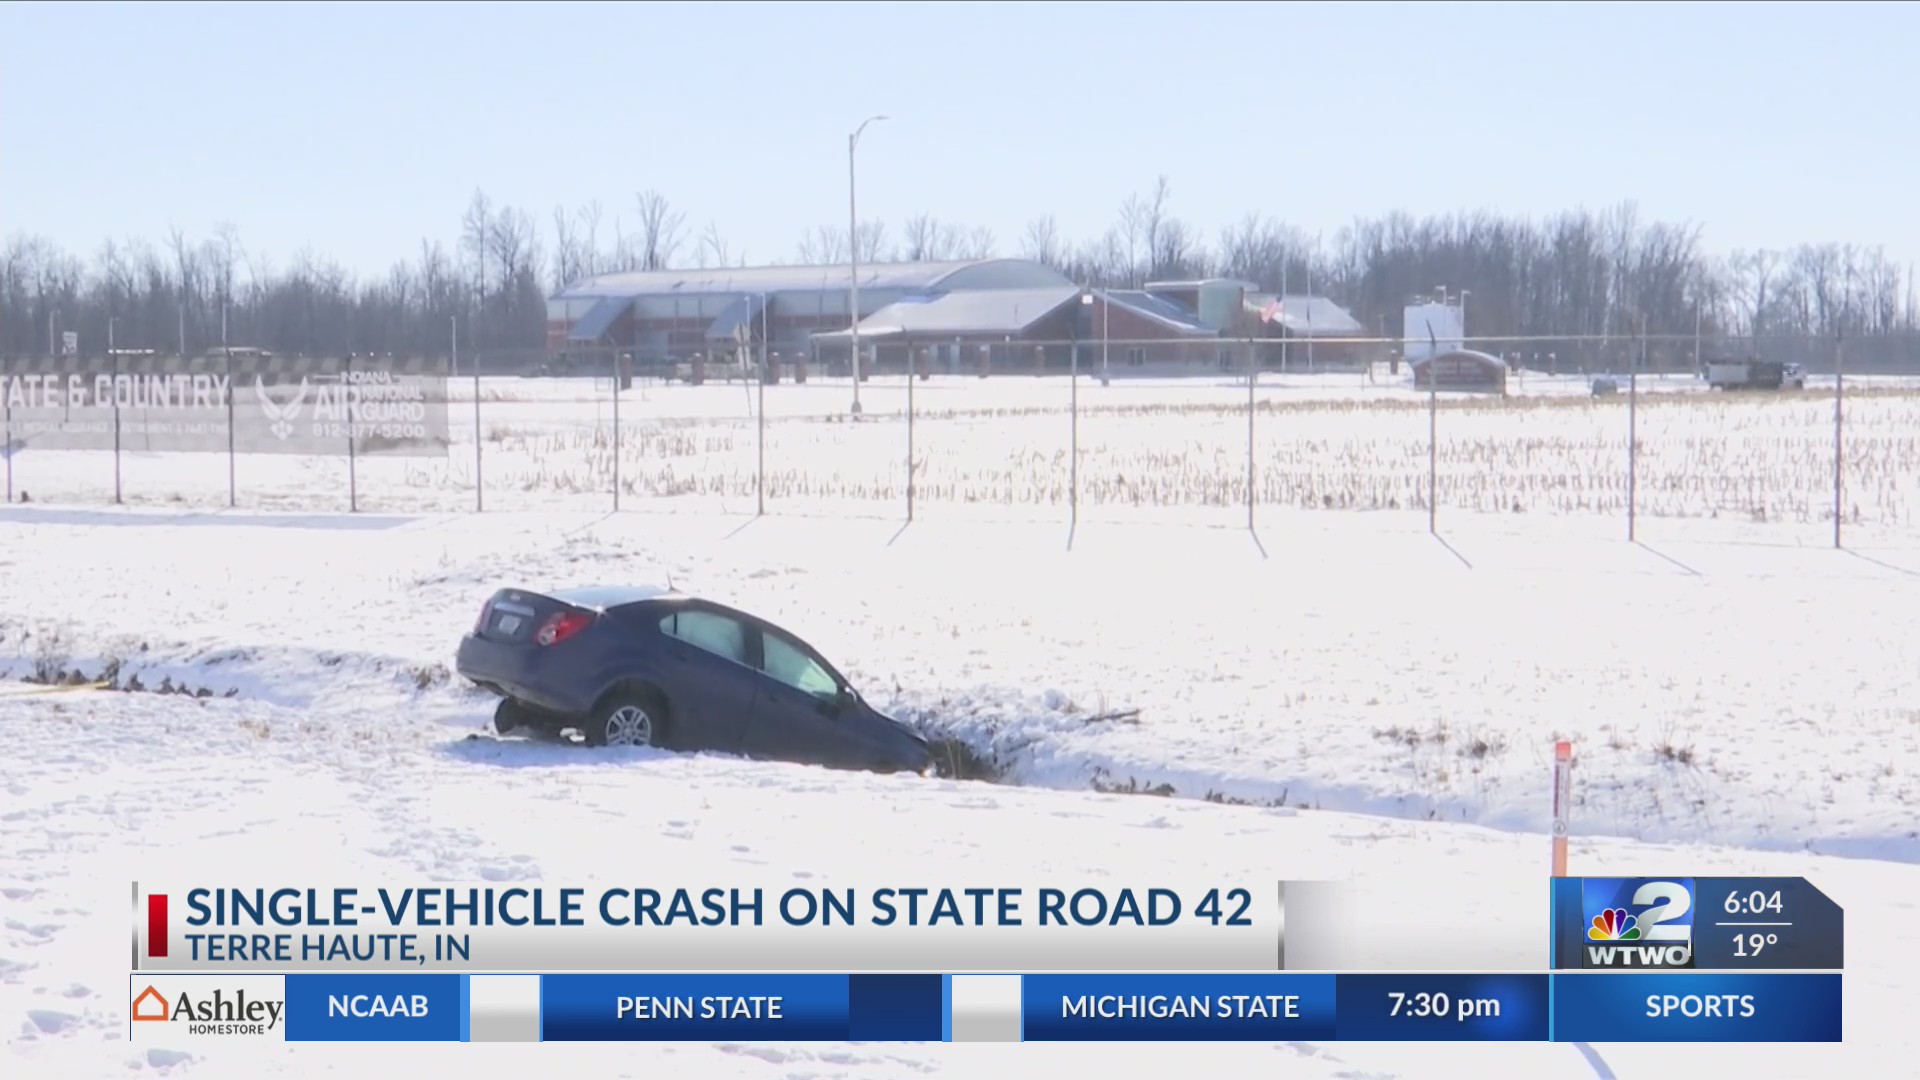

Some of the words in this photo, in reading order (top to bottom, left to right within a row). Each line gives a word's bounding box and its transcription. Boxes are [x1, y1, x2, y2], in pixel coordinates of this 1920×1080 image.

[340, 370, 392, 384] INDIANA
[68, 374, 88, 408] &
[94, 373, 230, 409] COUNTRY
[312, 385, 361, 420] AIR
[361, 385, 425, 401] NATIONAL
[362, 401, 425, 421] GUARD
